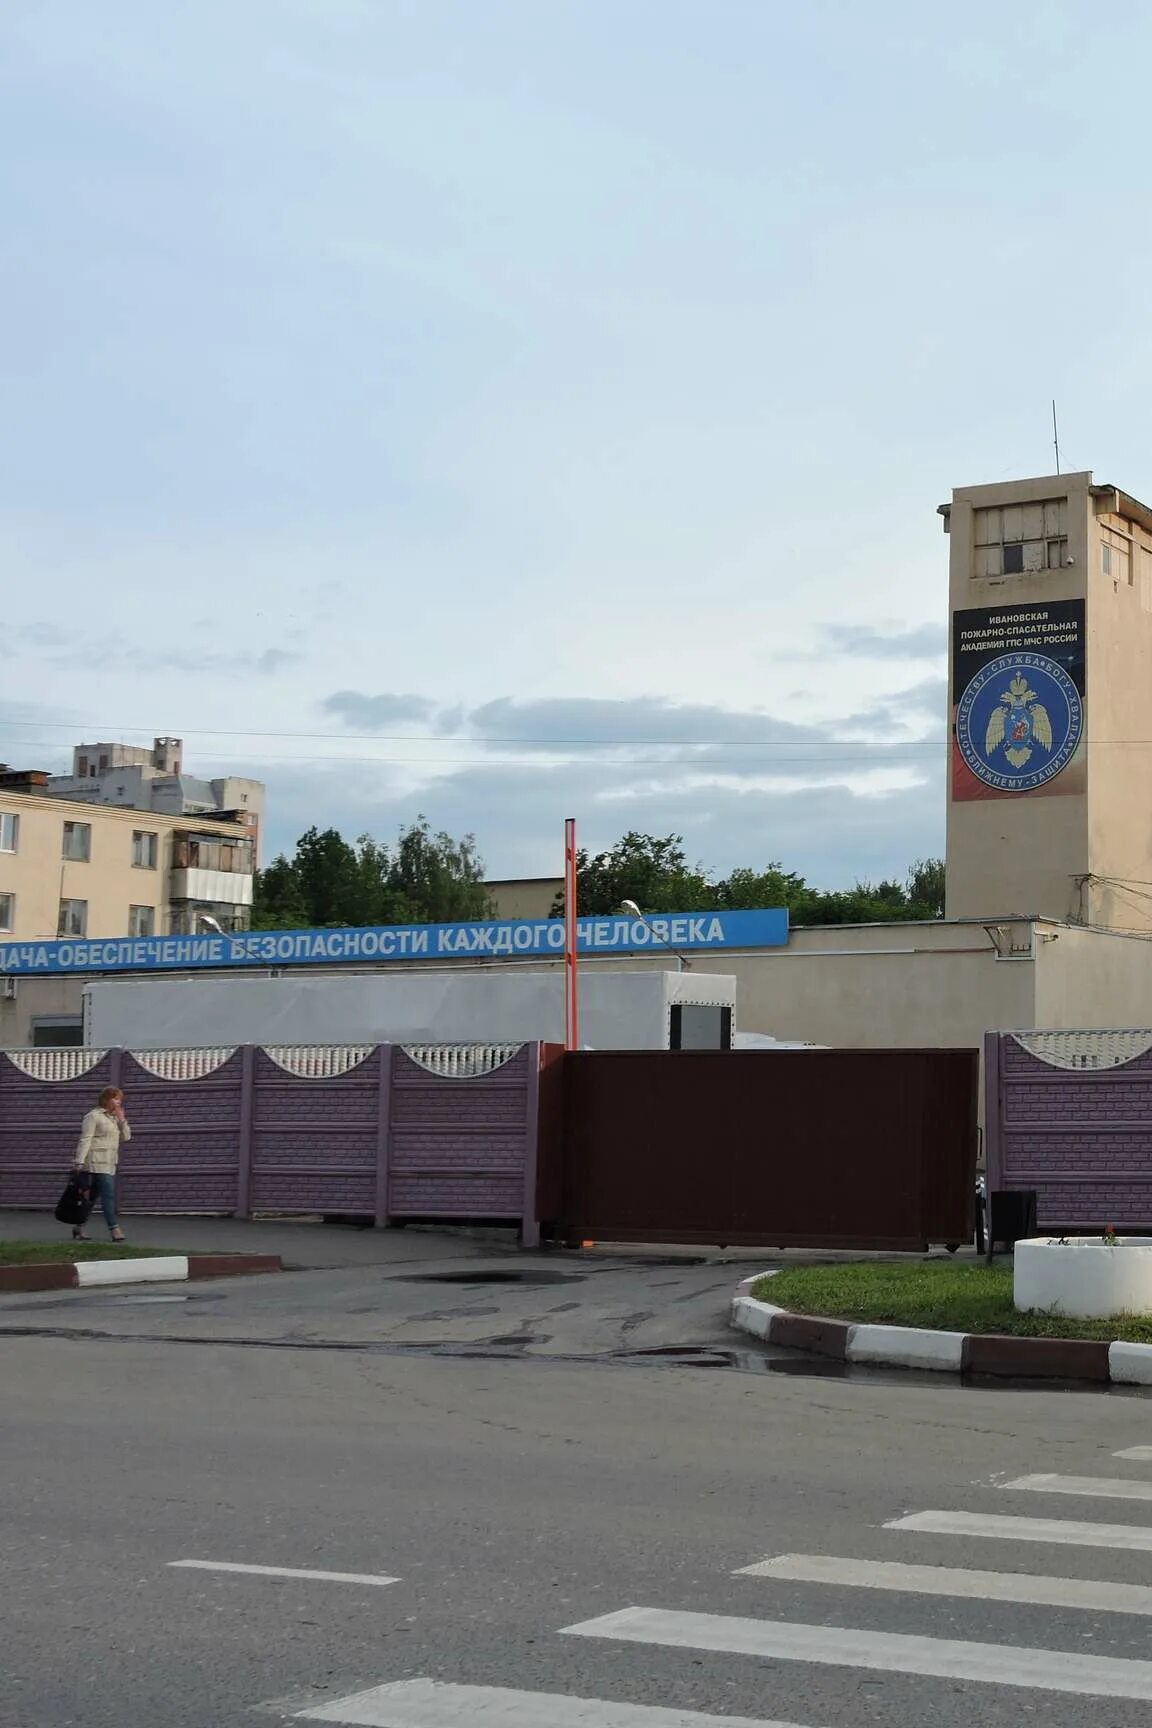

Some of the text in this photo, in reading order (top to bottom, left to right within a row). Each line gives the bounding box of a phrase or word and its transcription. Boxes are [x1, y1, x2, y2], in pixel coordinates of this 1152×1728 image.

[989, 612, 1049, 625] ИВАНОВСКАЯ
[960, 621, 1078, 640] ПОЖАРНО-СПАСАТЕЛЬНАЯ
[960, 633, 1078, 652] АКАДЕМИЯ ГПС МЧС РОССИИ
[230, 929, 428, 960] БЕЗОПАСНОСТИ
[437, 922, 566, 954] КАЖДОГО
[576, 916, 726, 947] ЧЕЛОВЕКА
